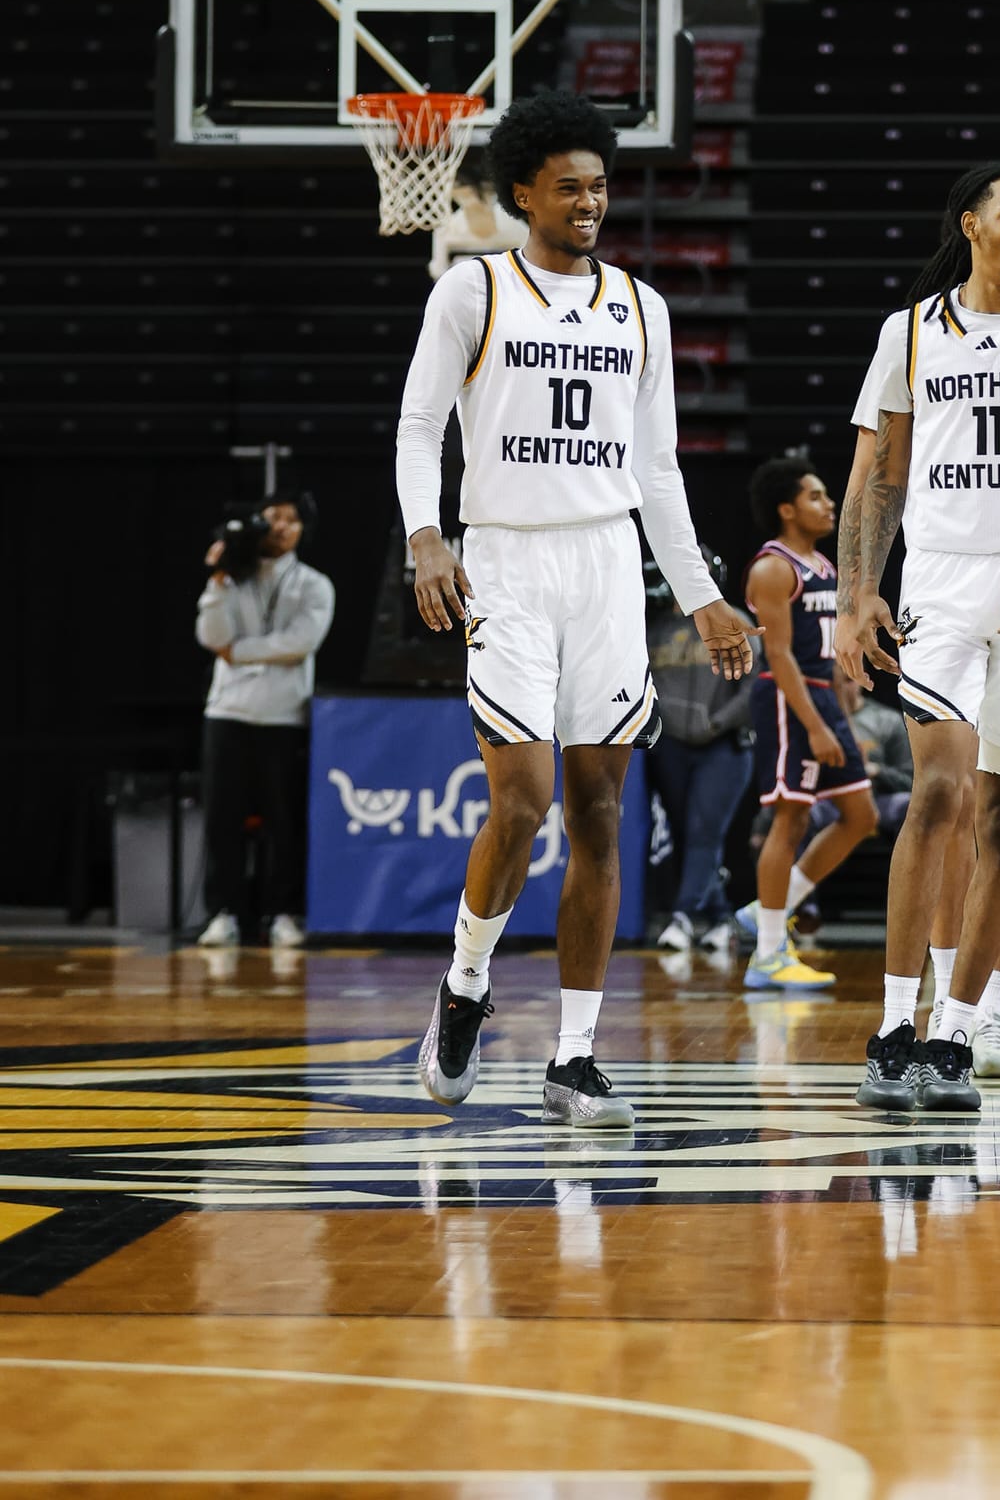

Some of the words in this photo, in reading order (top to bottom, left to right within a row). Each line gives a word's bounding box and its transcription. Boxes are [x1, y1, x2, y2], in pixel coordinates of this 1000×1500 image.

[504, 340, 634, 376] NORTHERN
[548, 377, 593, 431] 10
[502, 435, 627, 469] KENTUCKY
